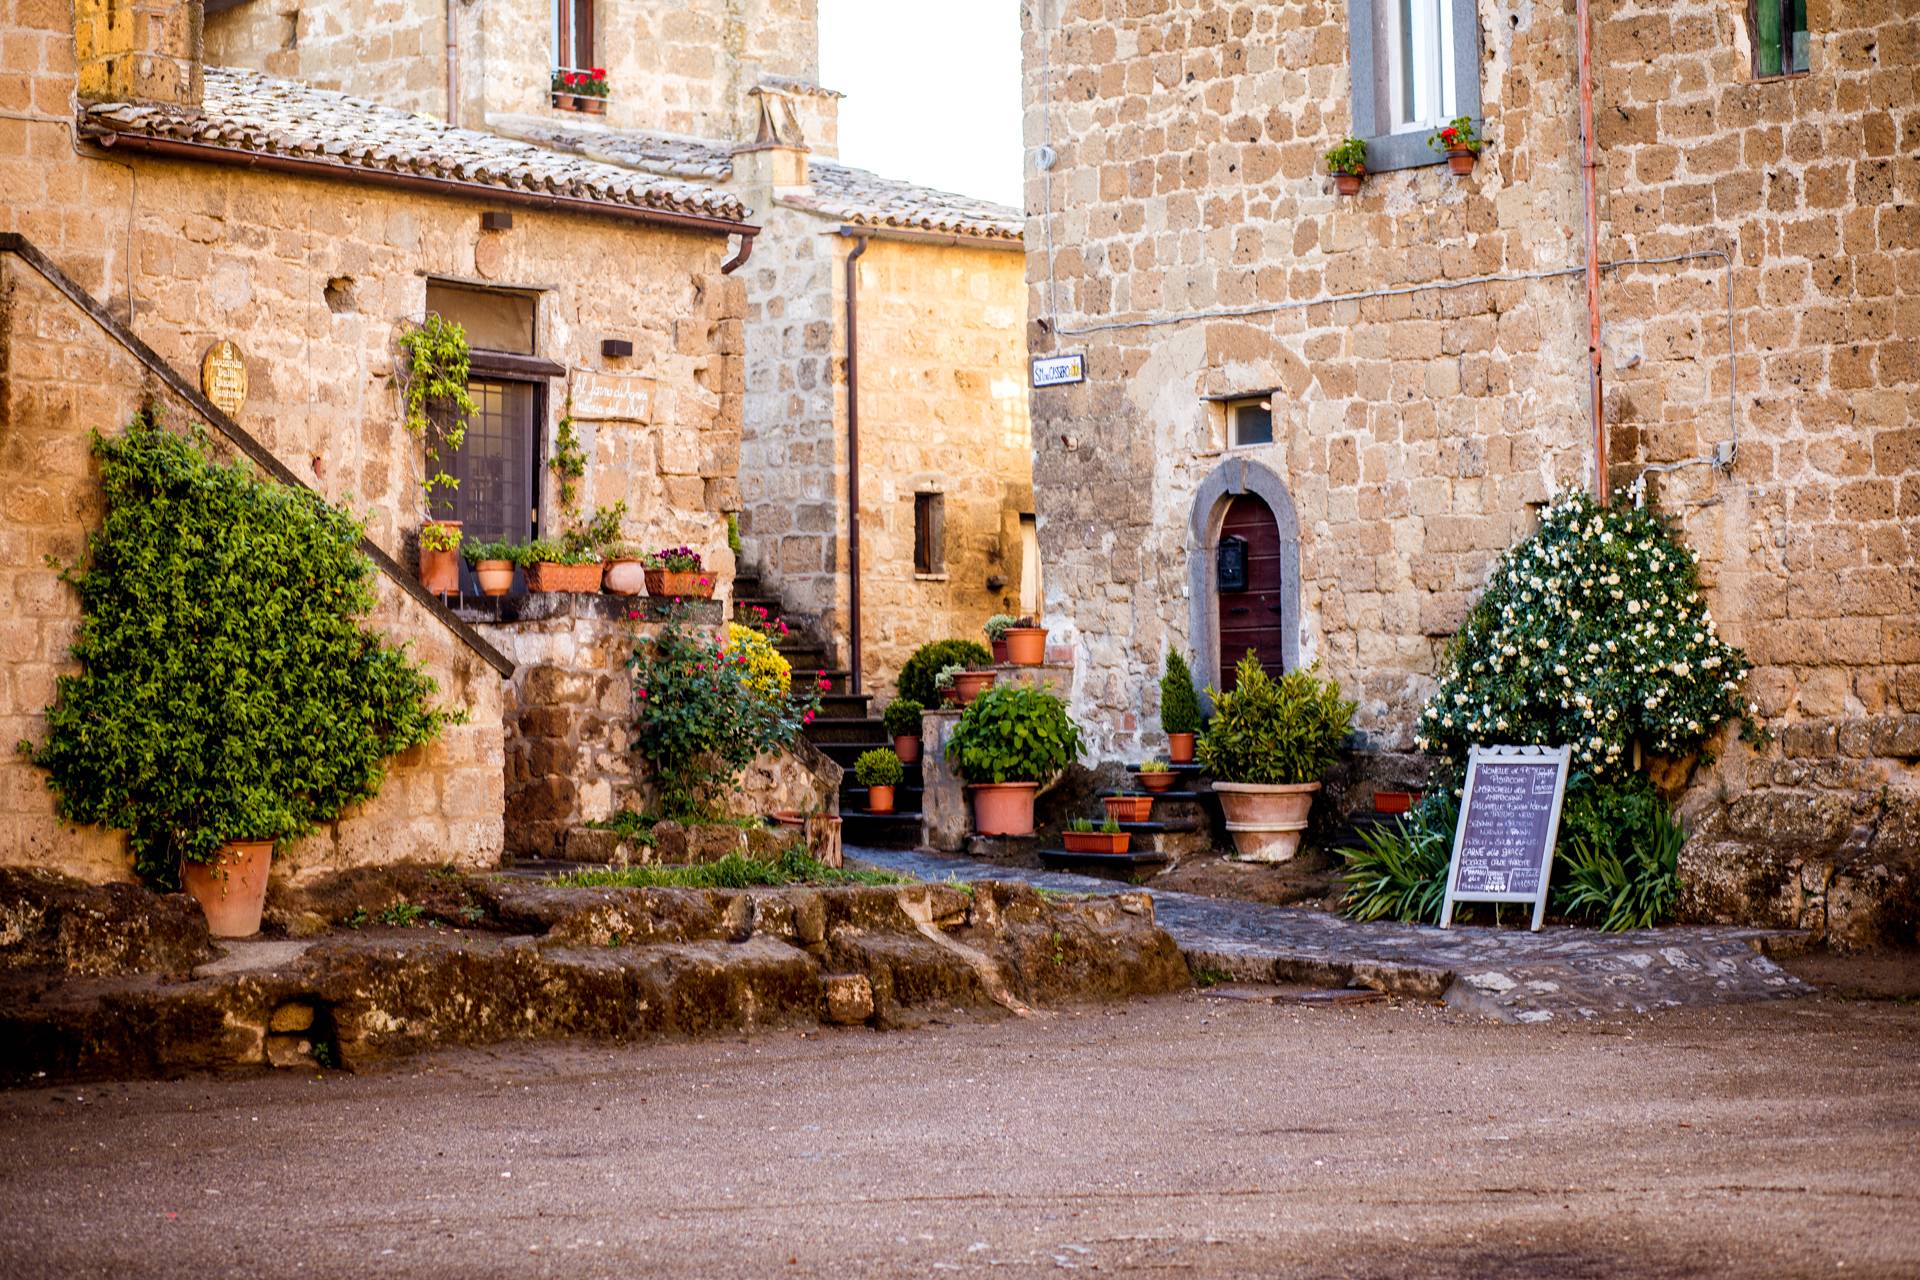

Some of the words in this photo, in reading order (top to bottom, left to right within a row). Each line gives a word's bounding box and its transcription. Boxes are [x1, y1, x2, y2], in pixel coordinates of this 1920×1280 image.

[212, 356, 243, 369] Locanda
[572, 374, 587, 395] Al
[1461, 846, 1486, 857] CARNE
